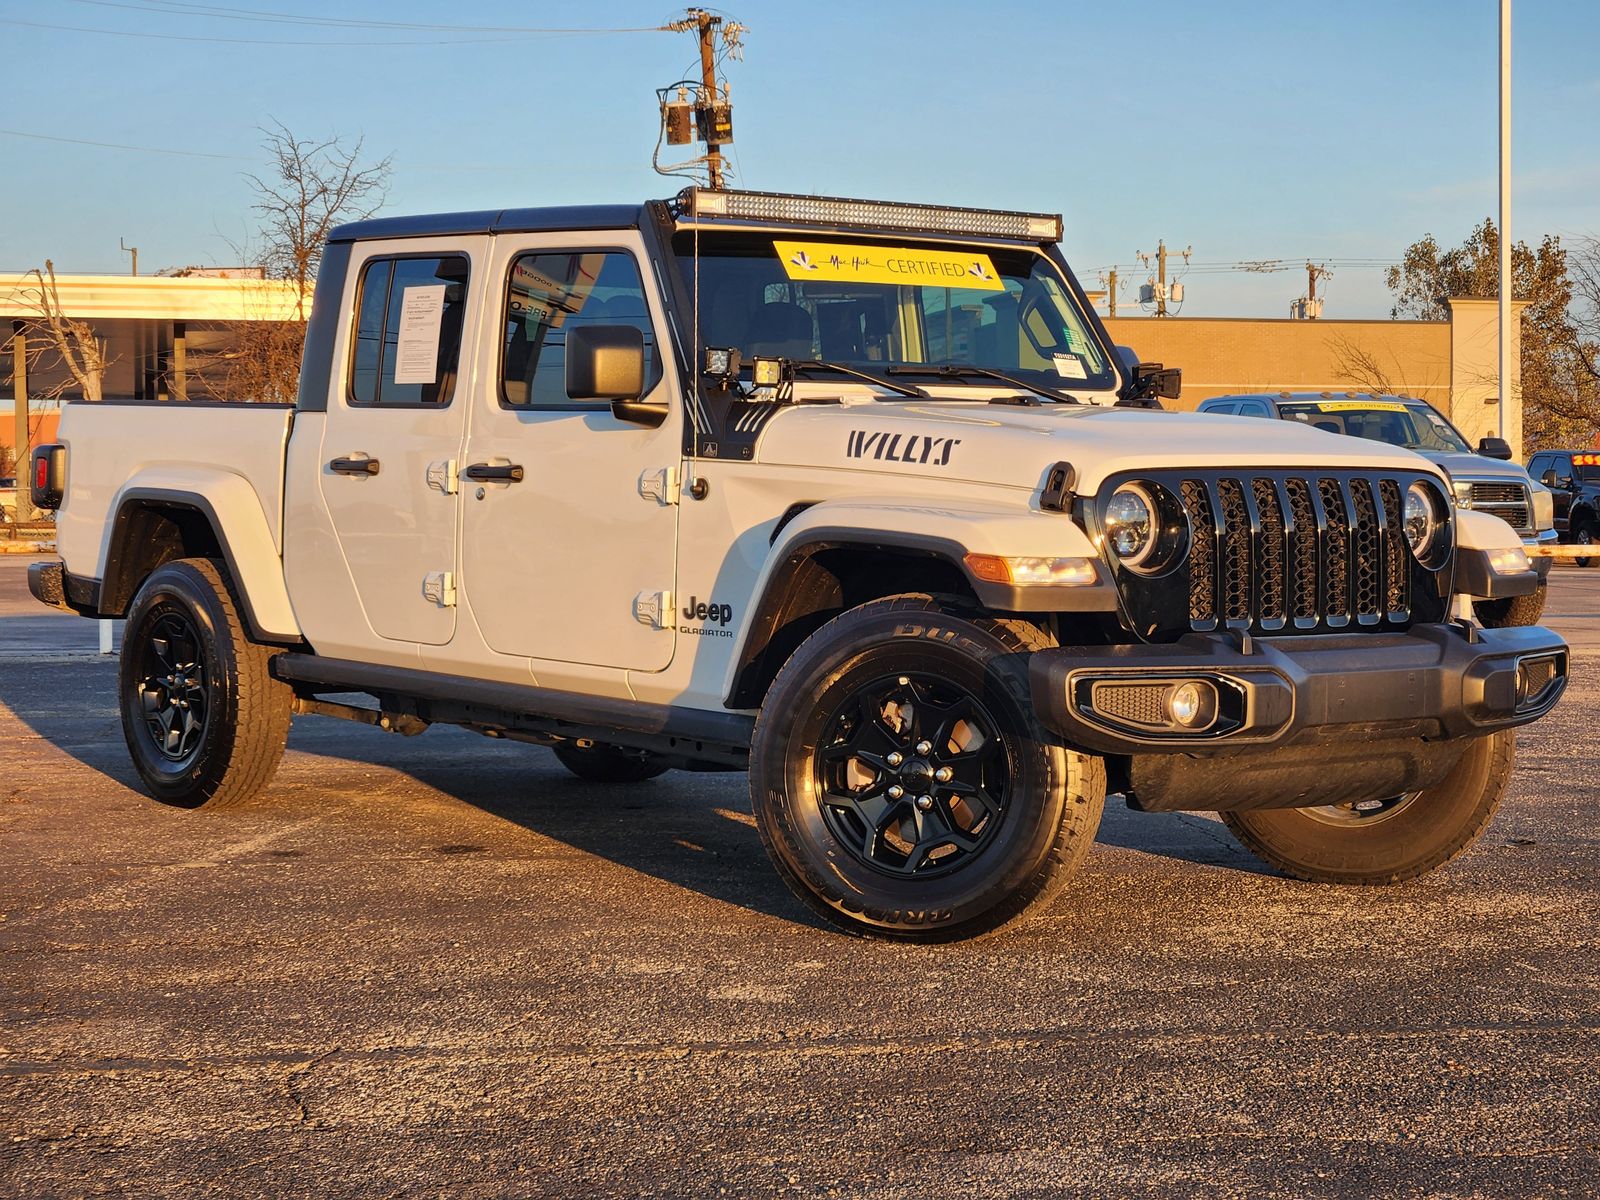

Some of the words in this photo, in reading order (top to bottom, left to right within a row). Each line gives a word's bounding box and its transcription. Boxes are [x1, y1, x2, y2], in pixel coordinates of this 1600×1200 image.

[886, 258, 966, 277] CERTIFIED
[846, 429, 962, 466] WILLYS
[682, 595, 733, 627] Jeep
[680, 626, 734, 638] GLADIATOR
